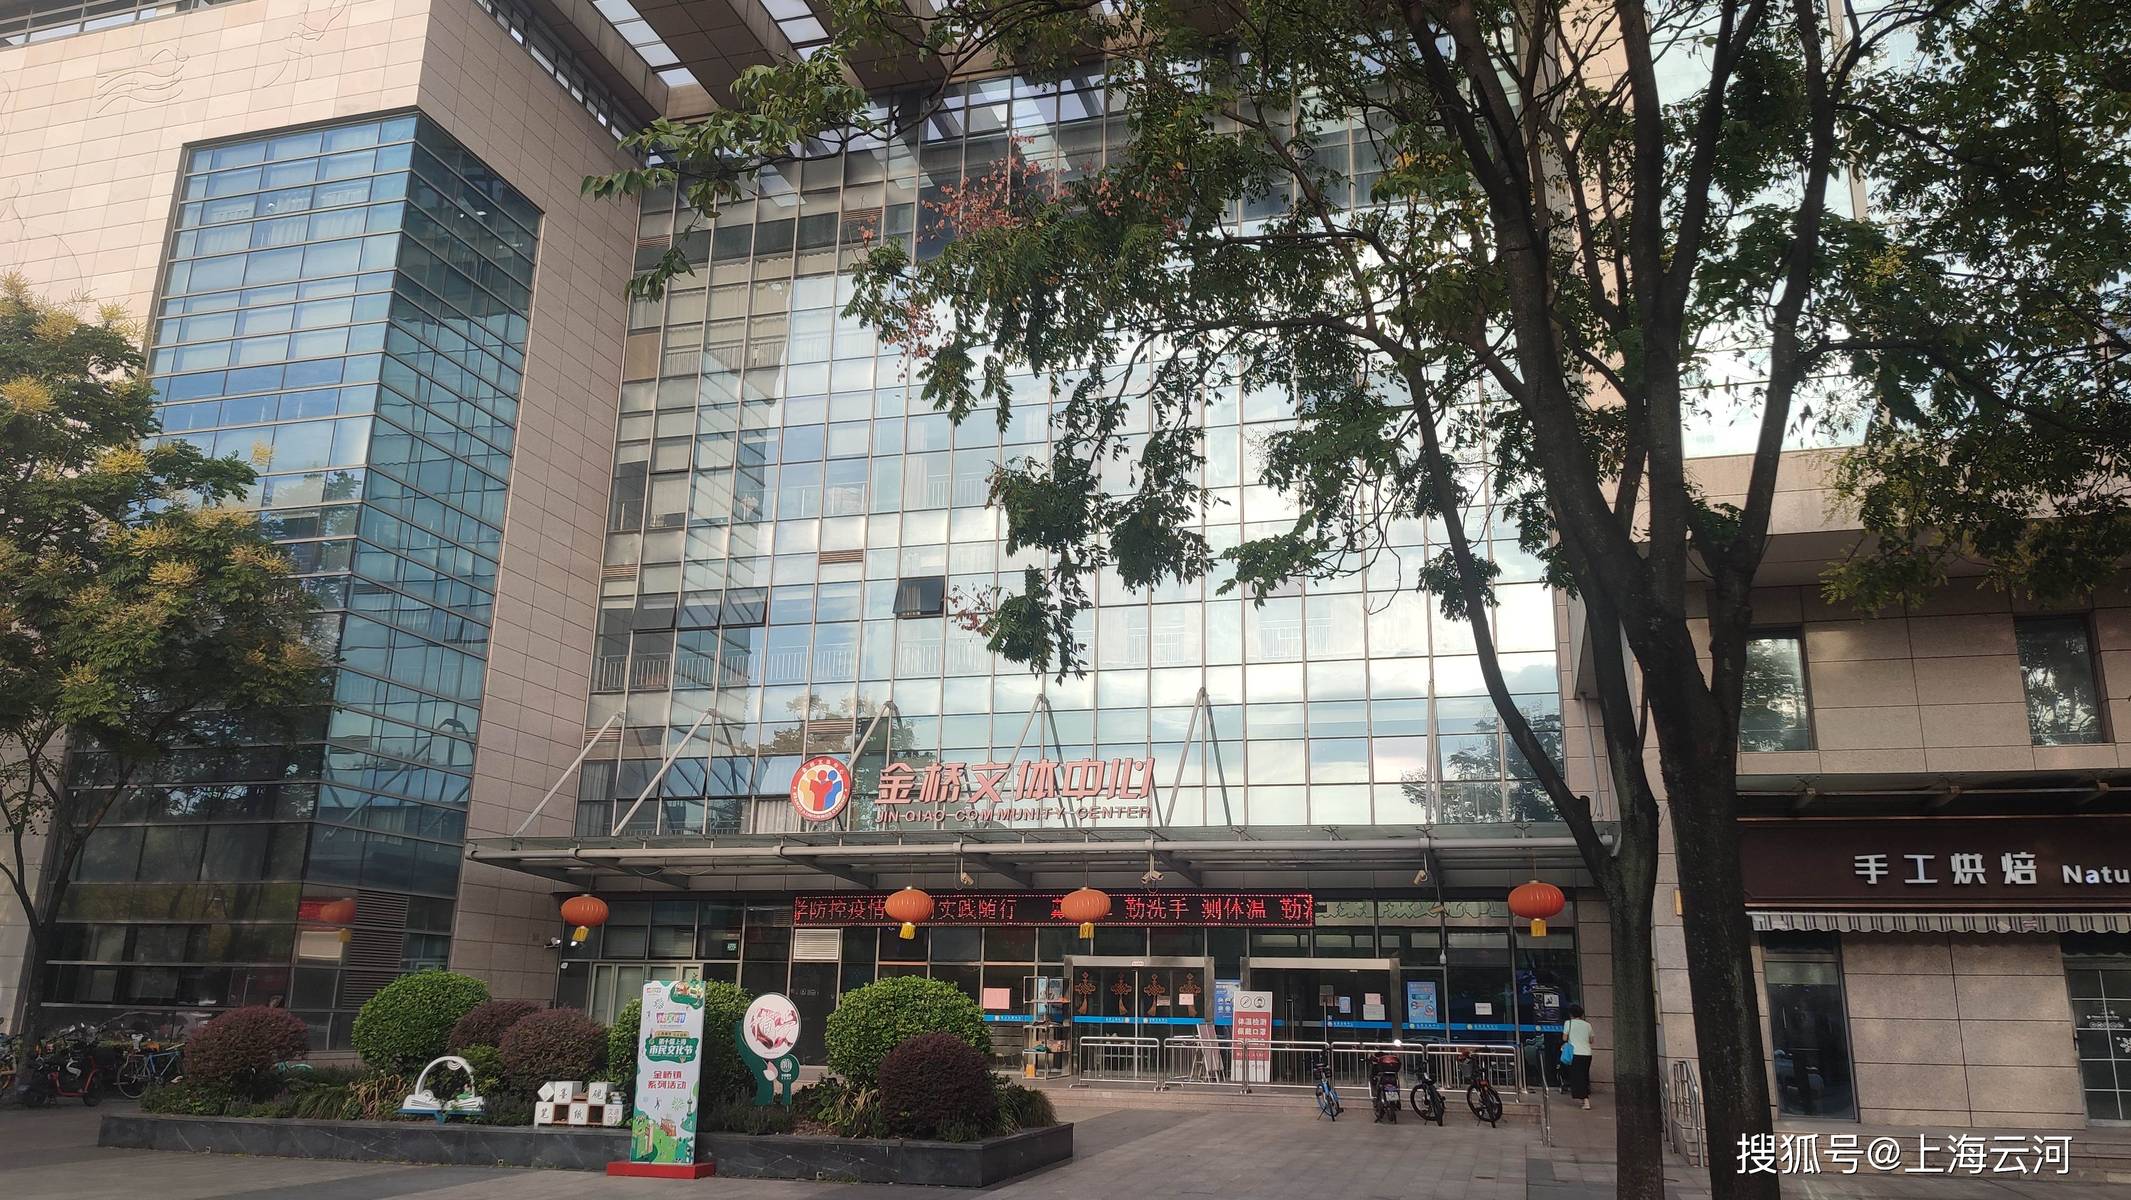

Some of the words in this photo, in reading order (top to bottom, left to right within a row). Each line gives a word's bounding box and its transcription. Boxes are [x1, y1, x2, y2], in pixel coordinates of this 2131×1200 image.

[875, 757, 1155, 804] 金桥文体中心
[875, 810, 900, 823] JIN
[905, 808, 946, 822] QIAO
[1076, 806, 1151, 820] CENTER
[1854, 851, 2038, 885] 手工烘焙
[2061, 863, 2131, 884] Natu
[649, 1045, 693, 1056] 市民文化节
